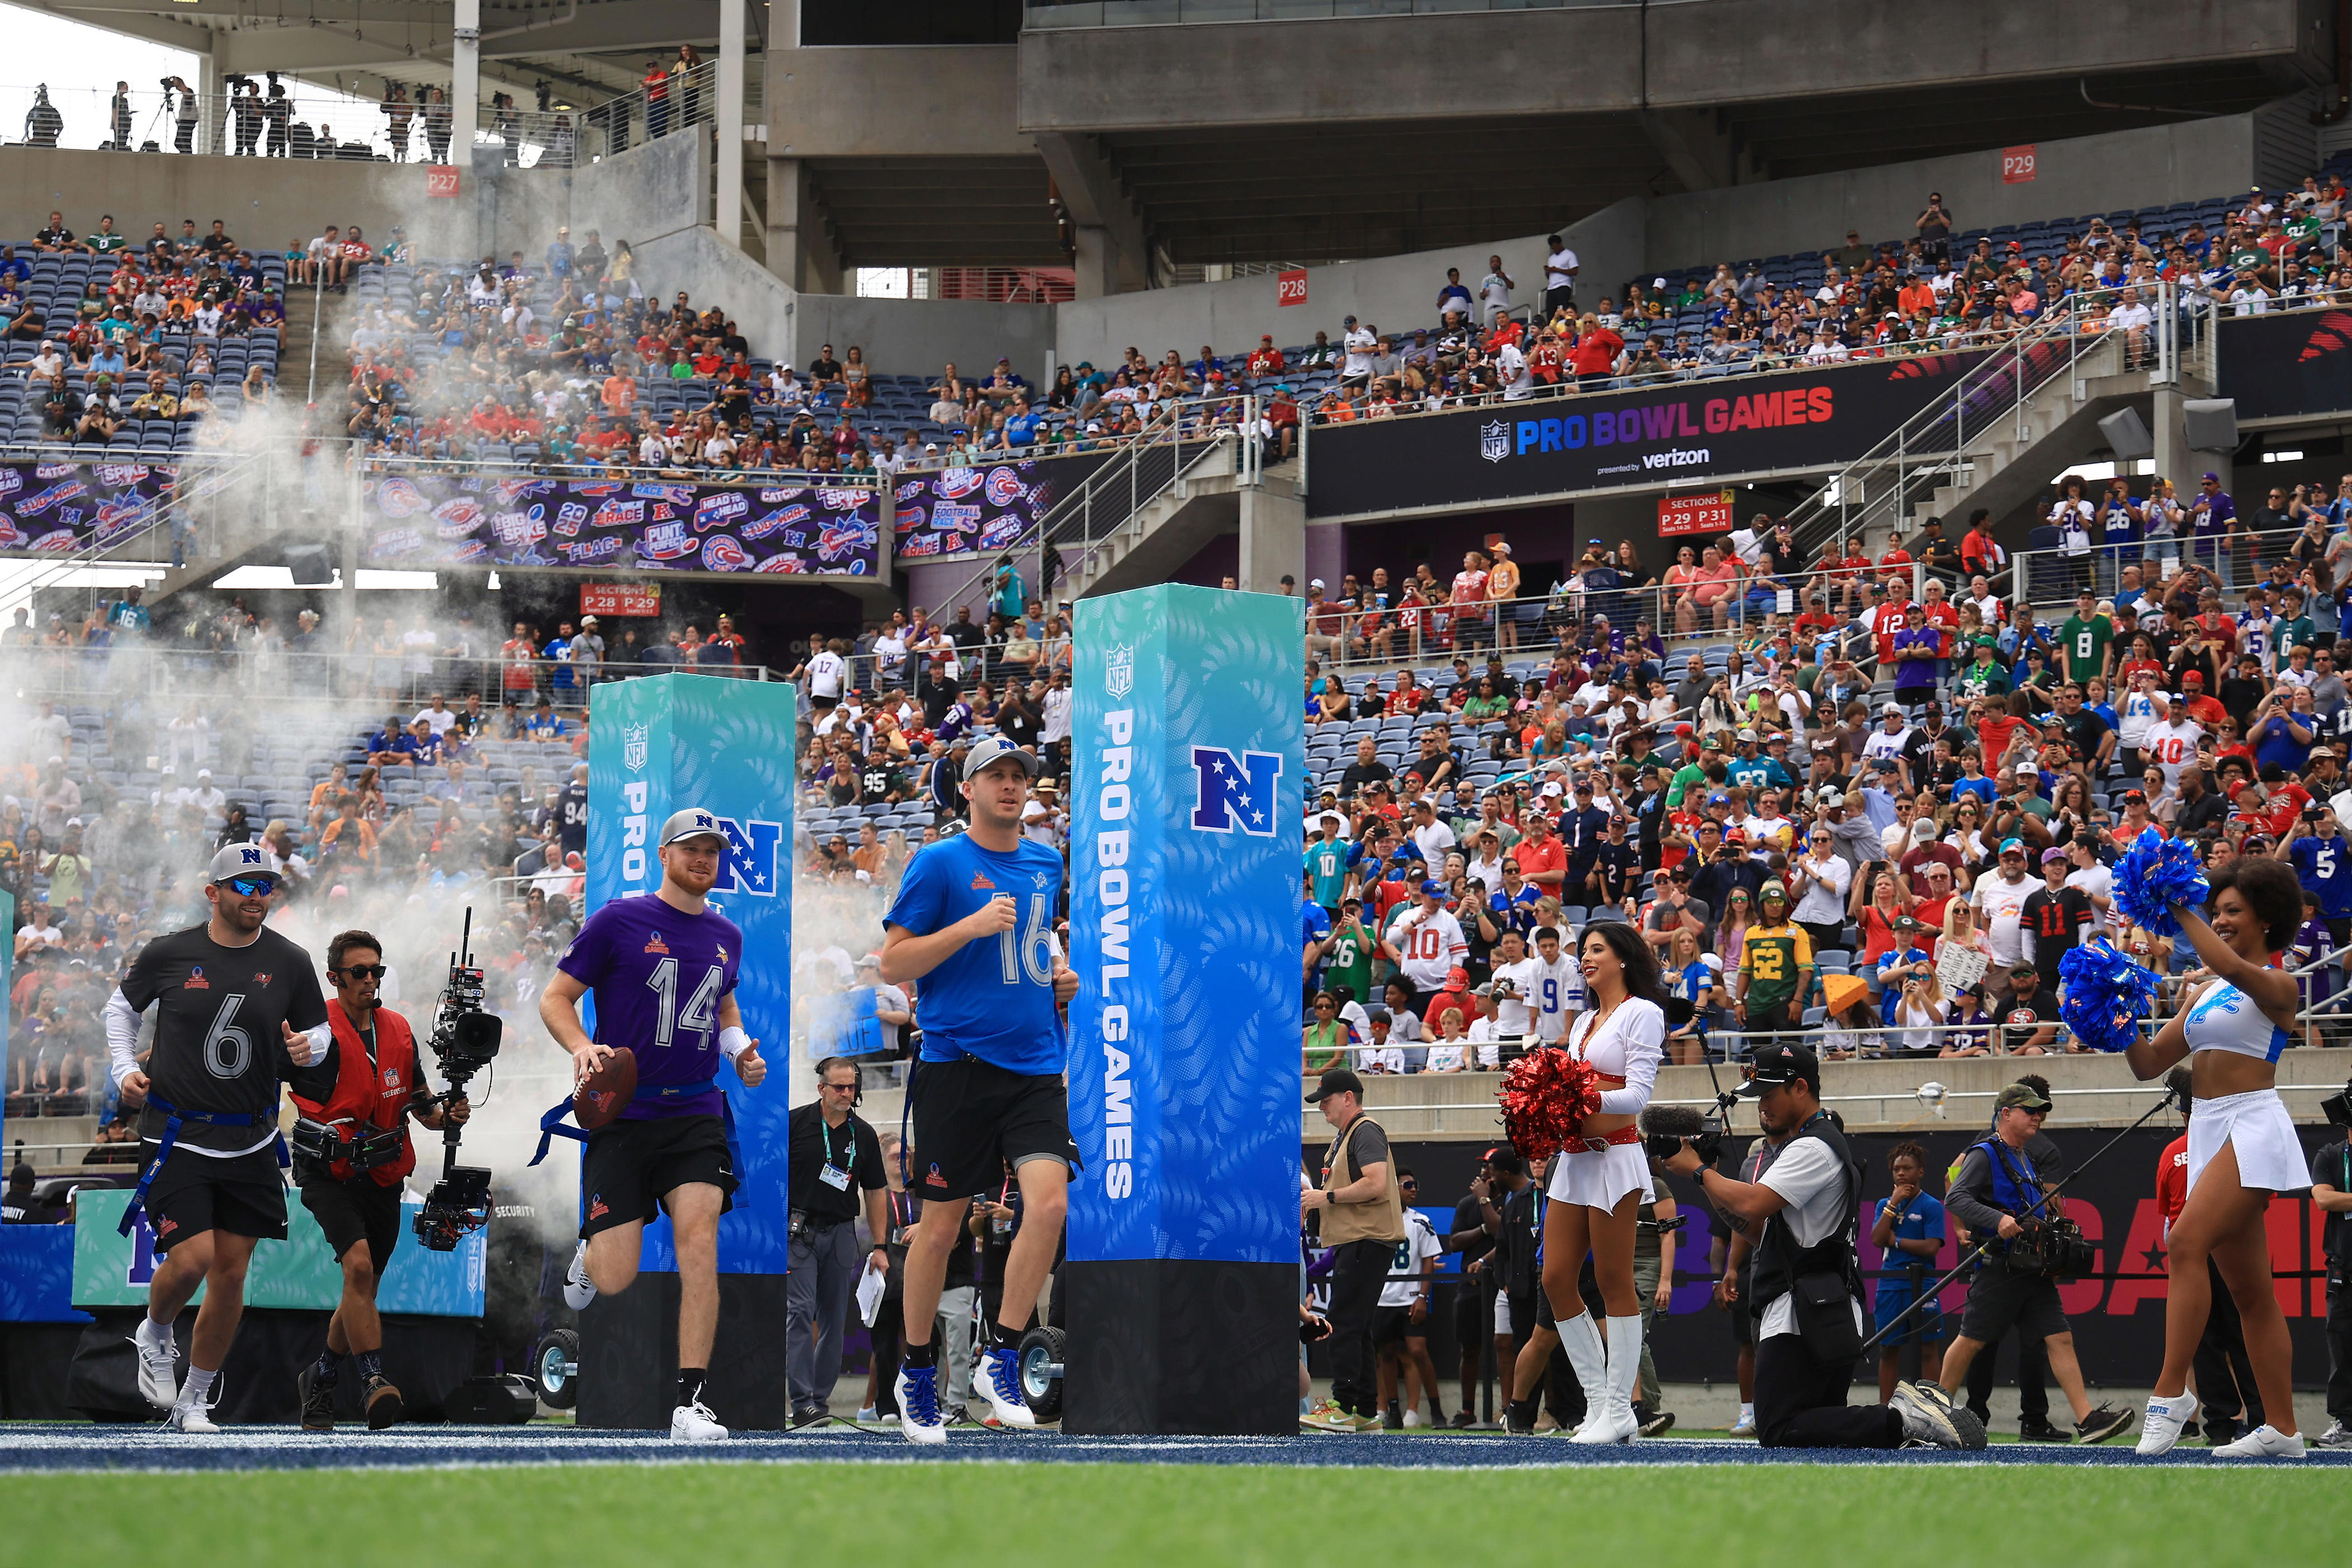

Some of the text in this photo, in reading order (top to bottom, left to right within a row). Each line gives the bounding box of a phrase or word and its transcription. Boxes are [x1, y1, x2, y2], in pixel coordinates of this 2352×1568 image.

[2004, 155, 2034, 175] P29
[429, 174, 457, 190] P27
[238, 276, 254, 290] 72
[1279, 279, 1306, 298] P28
[112, 327, 128, 345] 10
[1538, 349, 1558, 367] 13
[1484, 386, 1833, 457] NFL PRO BOWL GAMES
[1598, 448, 1710, 475] presented by verizon
[635, 486, 663, 496] RACE
[703, 494, 741, 510] HEAD TO
[719, 499, 745, 516] HEAD
[1671, 497, 1718, 509] SECTIONS
[502, 513, 525, 527] BIG
[605, 508, 642, 523] RACE
[933, 517, 955, 526] RACE
[935, 507, 979, 517] FOOTBALL
[1661, 509, 1727, 526] P 29 P 31
[2106, 508, 2129, 531] 26
[504, 523, 546, 541] SPIKE
[648, 522, 682, 542] PUNT
[986, 518, 1007, 533] HEAD
[998, 523, 1020, 539] HEAD
[570, 537, 613, 561] FLAG
[649, 536, 684, 551] PERFECT
[909, 541, 938, 556] RACE
[595, 585, 645, 595] SECTIONS
[584, 596, 655, 608] P 28 P 29
[120, 608, 138, 629] 16
[1400, 609, 1418, 627] 22
[1881, 614, 1904, 635] 12
[2077, 631, 2093, 658] 8
[2249, 630, 2263, 654] 5
[2281, 632, 2293, 657] 6
[818, 662, 832, 674] 17
[882, 653, 895, 665] 18
[1109, 667, 1131, 691] NFL
[2128, 698, 2151, 717] 14
[627, 744, 646, 764] NFL
[2157, 738, 2183, 763] 10
[863, 772, 887, 794] 95
[1735, 769, 1768, 788] 93
[564, 803, 588, 825] 94
[623, 781, 648, 882] PRO
[1573, 822, 1581, 848] 1
[240, 848, 262, 866] N
[1319, 854, 1336, 877] 10
[2316, 848, 2336, 879] 5
[1608, 864, 1617, 884] 2
[2040, 903, 2066, 937] 11
[991, 891, 1054, 987] 16
[1406, 928, 1439, 960] 10
[1098, 709, 1134, 1199] PRO BOWL GAMES
[1330, 939, 1357, 969] 26
[1752, 947, 1784, 980] 52
[646, 957, 724, 1051] 14
[1543, 979, 1558, 1014] 9
[203, 993, 253, 1080] 6
[386, 1076, 398, 1085] NFL
[381, 1085, 407, 1099] TELEVISION
[494, 1205, 536, 1219] SECURITY
[2146, 1405, 2170, 1415] IONS
